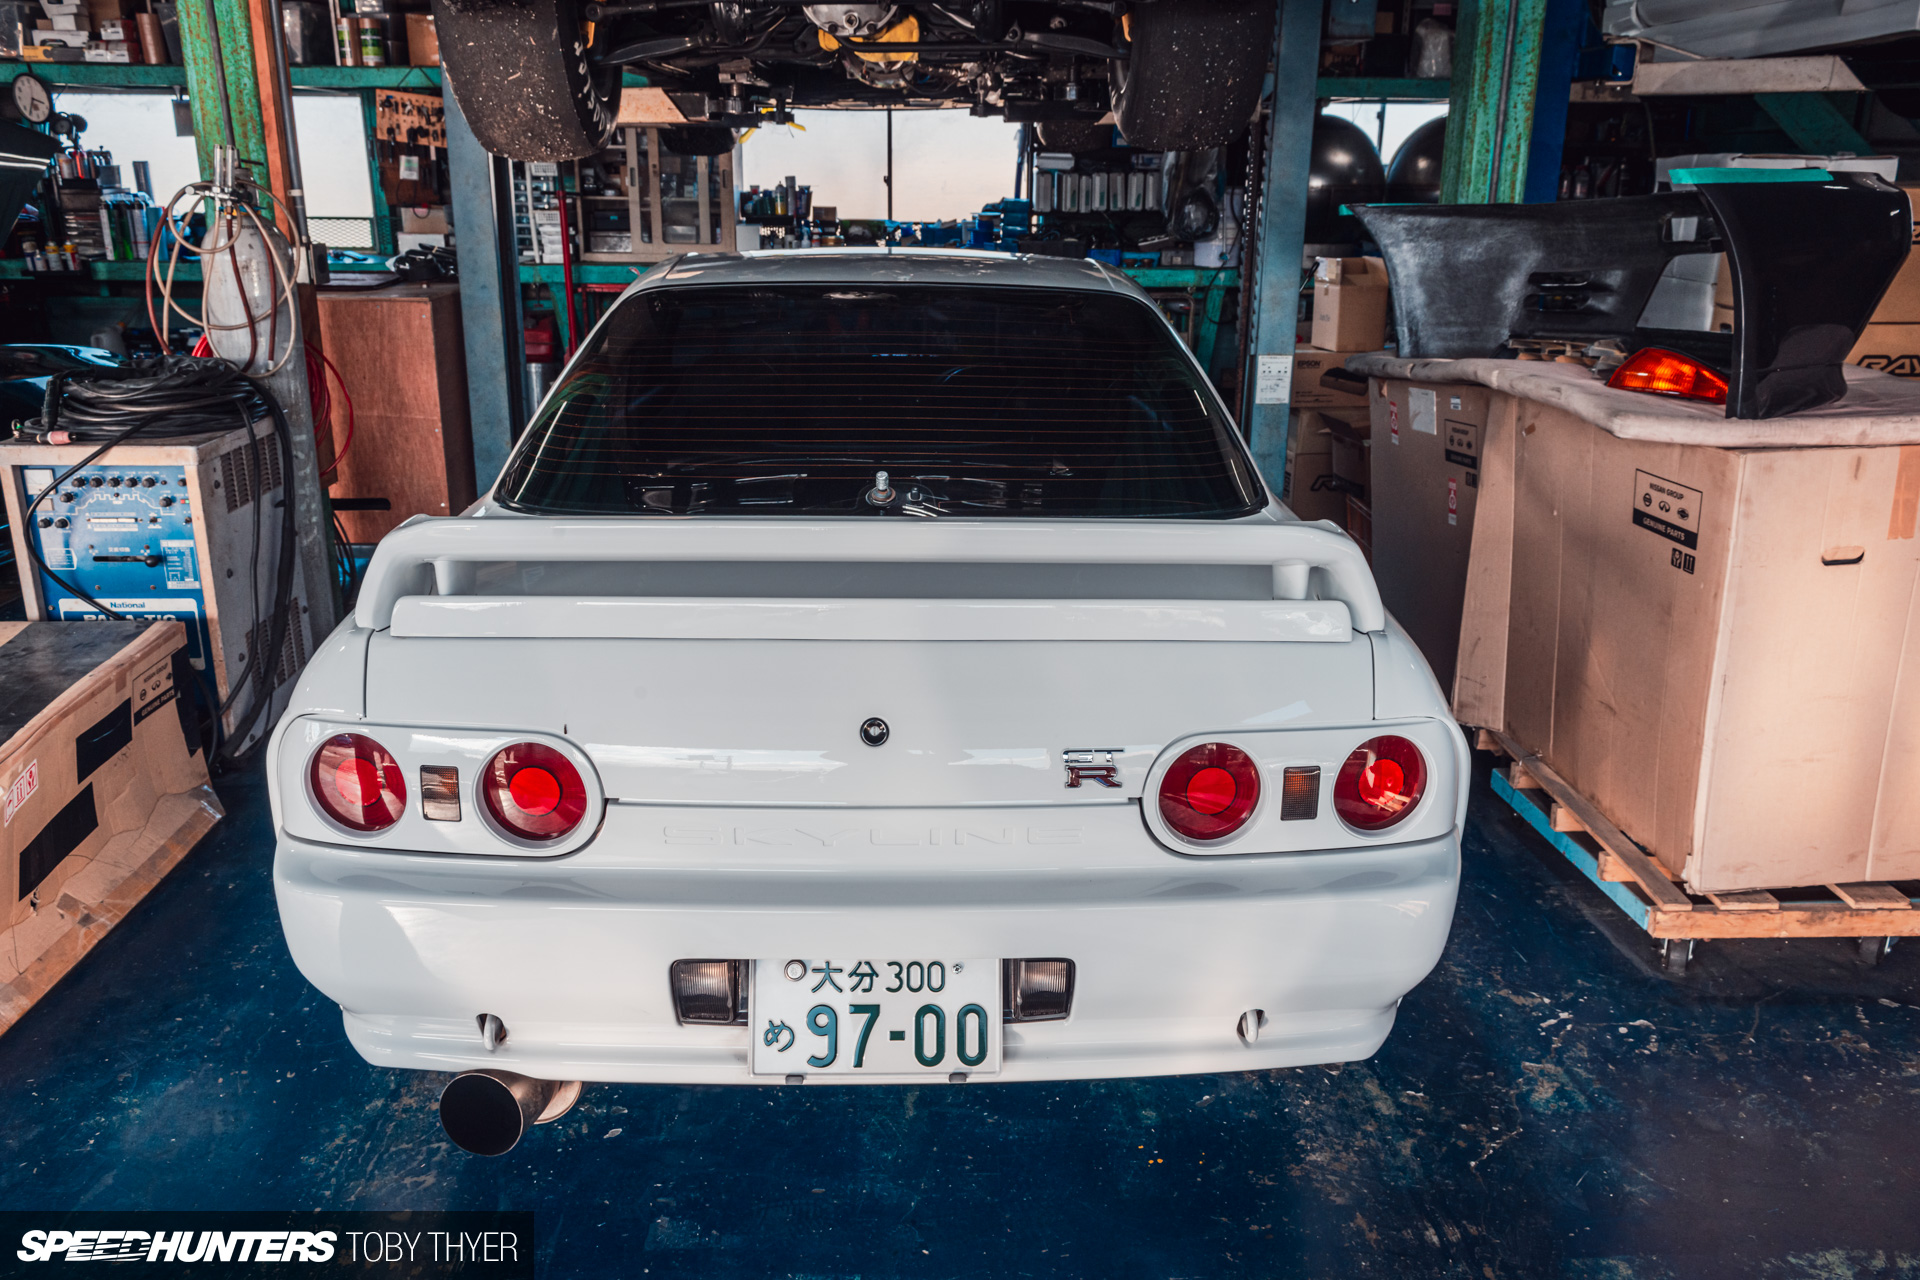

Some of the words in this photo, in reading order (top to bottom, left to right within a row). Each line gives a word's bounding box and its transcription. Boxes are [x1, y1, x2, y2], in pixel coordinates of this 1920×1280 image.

[1649, 482, 1666, 495] NISSAN
[1666, 488, 1684, 500] GROUP
[1643, 517, 1666, 533] GENUINE
[1666, 526, 1686, 541] PARTS
[662, 825, 1086, 847] SKYLINE
[763, 1019, 795, 1053] め
[806, 1003, 988, 1068] 97-00
